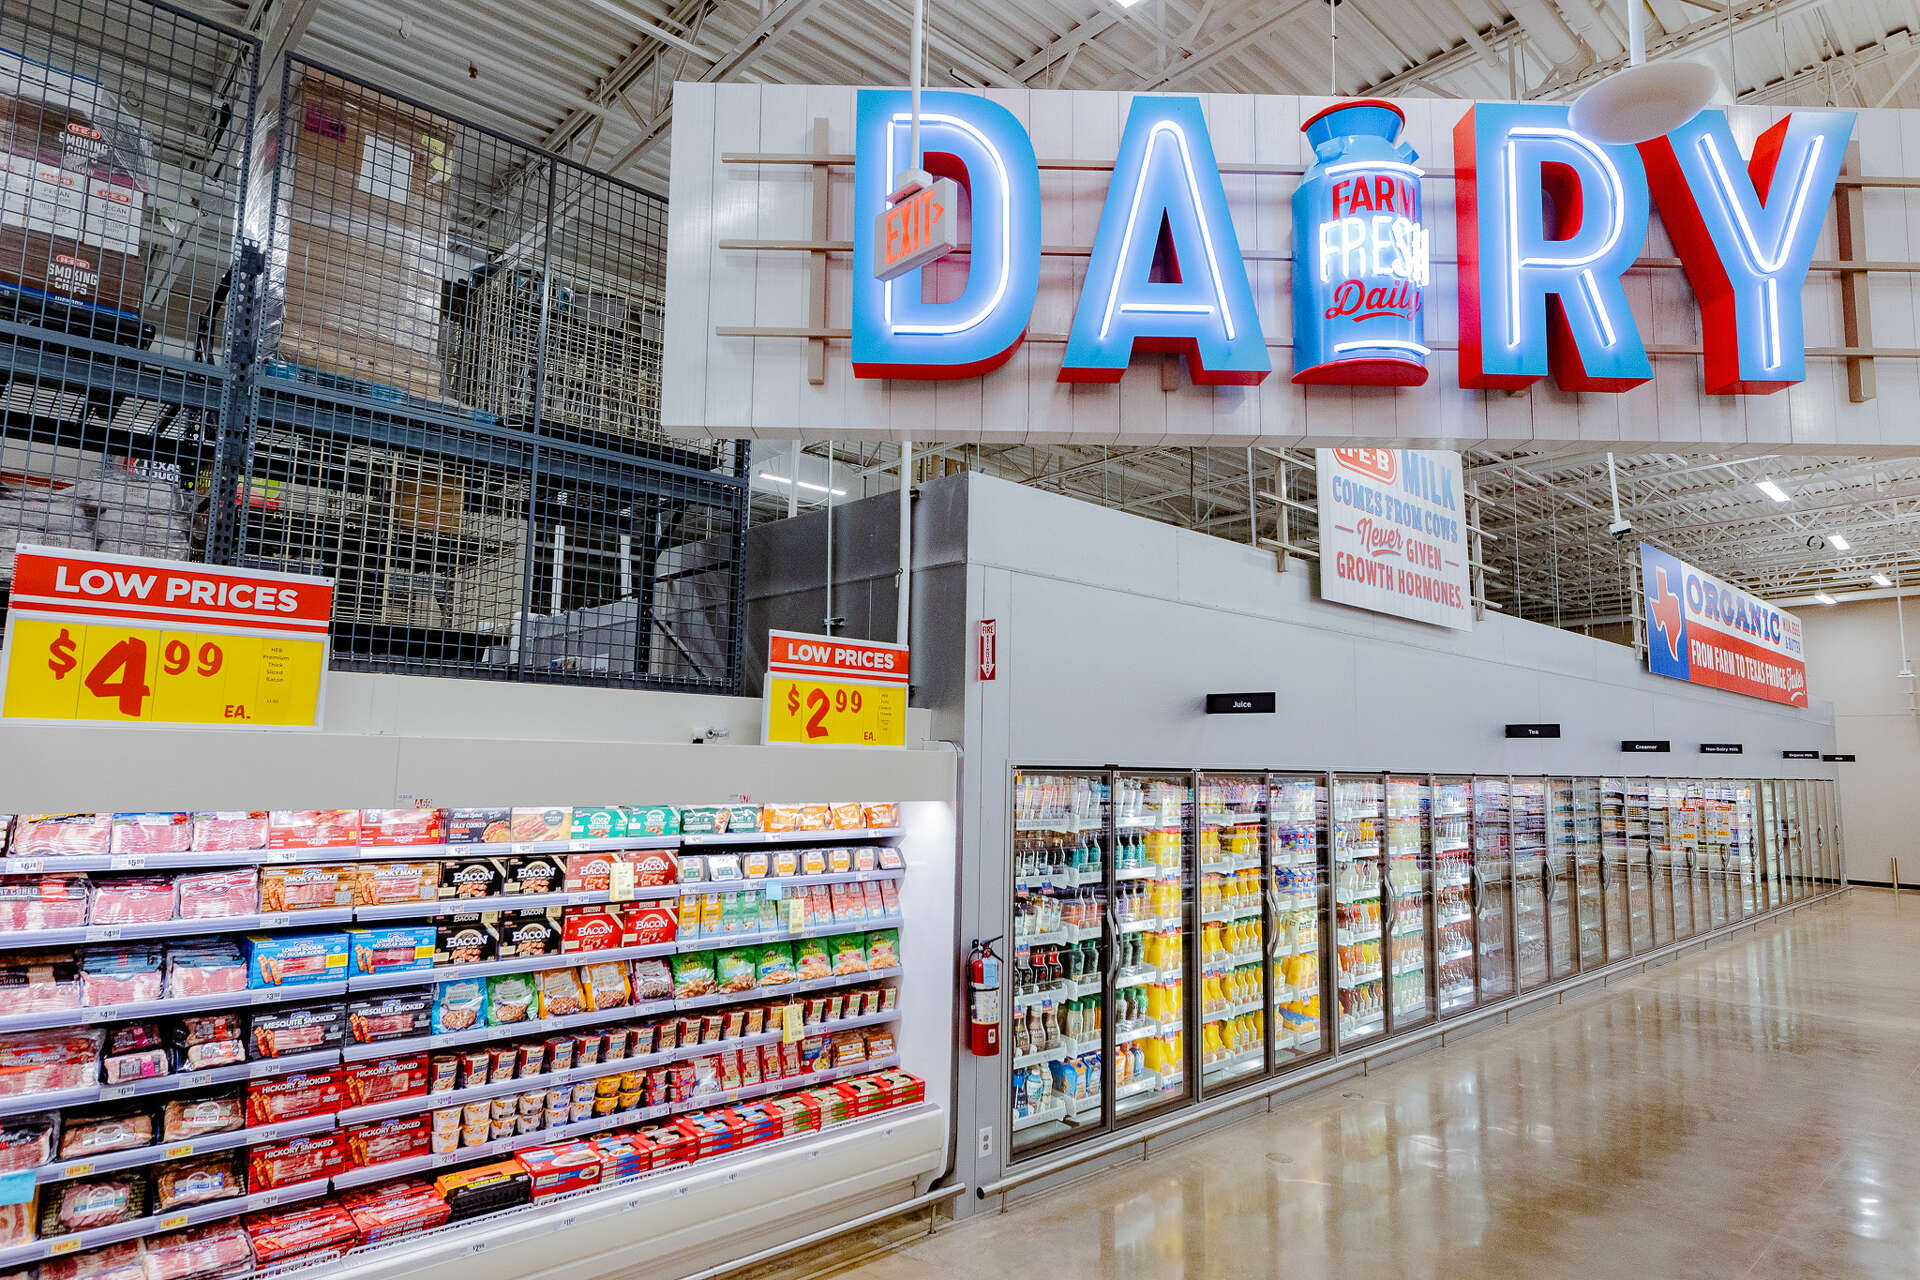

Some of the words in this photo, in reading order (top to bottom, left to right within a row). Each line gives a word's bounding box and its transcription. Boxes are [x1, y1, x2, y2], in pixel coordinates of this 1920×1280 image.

[1332, 175, 1416, 222] FARM
[885, 188, 936, 266] EXIT
[1319, 215, 1430, 287] FRESH
[48, 263, 98, 286] SMOKING
[1325, 279, 1421, 321] Daily
[1402, 449, 1456, 511] MILK
[1332, 475, 1383, 517] COMES
[1385, 495, 1423, 531] FROM
[1425, 511, 1458, 544] COWS
[1357, 518, 1403, 552] Never
[1406, 538, 1442, 571] GIVEN
[1336, 551, 1394, 591] GROWTH
[1398, 569, 1464, 609] HORMONES.
[55, 566, 157, 599] LOW
[165, 577, 298, 613] PRICES
[1686, 574, 1781, 645] ORGANIC
[982, 625, 994, 634] FIRE
[787, 642, 831, 663] LOW
[835, 647, 894, 670] PRICES
[1691, 639, 1713, 670] FROM
[1714, 647, 1735, 676] FARM
[1735, 653, 1745, 678] TO
[1745, 655, 1765, 683] TEXAS
[1765, 663, 1786, 690] FRIDGE
[224, 704, 251, 720] EA.
[1232, 700, 1252, 709] Juice
[374, 870, 399, 879] SMOKY
[400, 868, 424, 878] MAPLE
[516, 867, 556, 879] BACON
[637, 862, 669, 872] BACON
[284, 874, 313, 884] SMOKY
[314, 873, 338, 882] MAPLE
[452, 870, 495, 883] BACON
[453, 913, 480, 923] BACON
[520, 908, 545, 917] BACON
[577, 925, 614, 937] BACON
[635, 919, 668, 931] BACON
[446, 935, 488, 948] BACON
[512, 929, 552, 942] BACON
[357, 1004, 394, 1017] MESQUITE
[394, 1002, 425, 1014] SMOKED
[263, 1016, 303, 1029] MESQUITE
[303, 1014, 337, 1025] SMOKED
[356, 1066, 387, 1078] HICKORY
[387, 1062, 418, 1073] SMOKED
[262, 1082, 297, 1094] HICKORY
[297, 1076, 331, 1089] SMOKED
[358, 1127, 389, 1139] HICKORY
[389, 1120, 421, 1133] SMOKED
[264, 1147, 299, 1160] HICKORY
[300, 1139, 334, 1152] SMOKED
[309, 1238, 333, 1249] SMOKED
